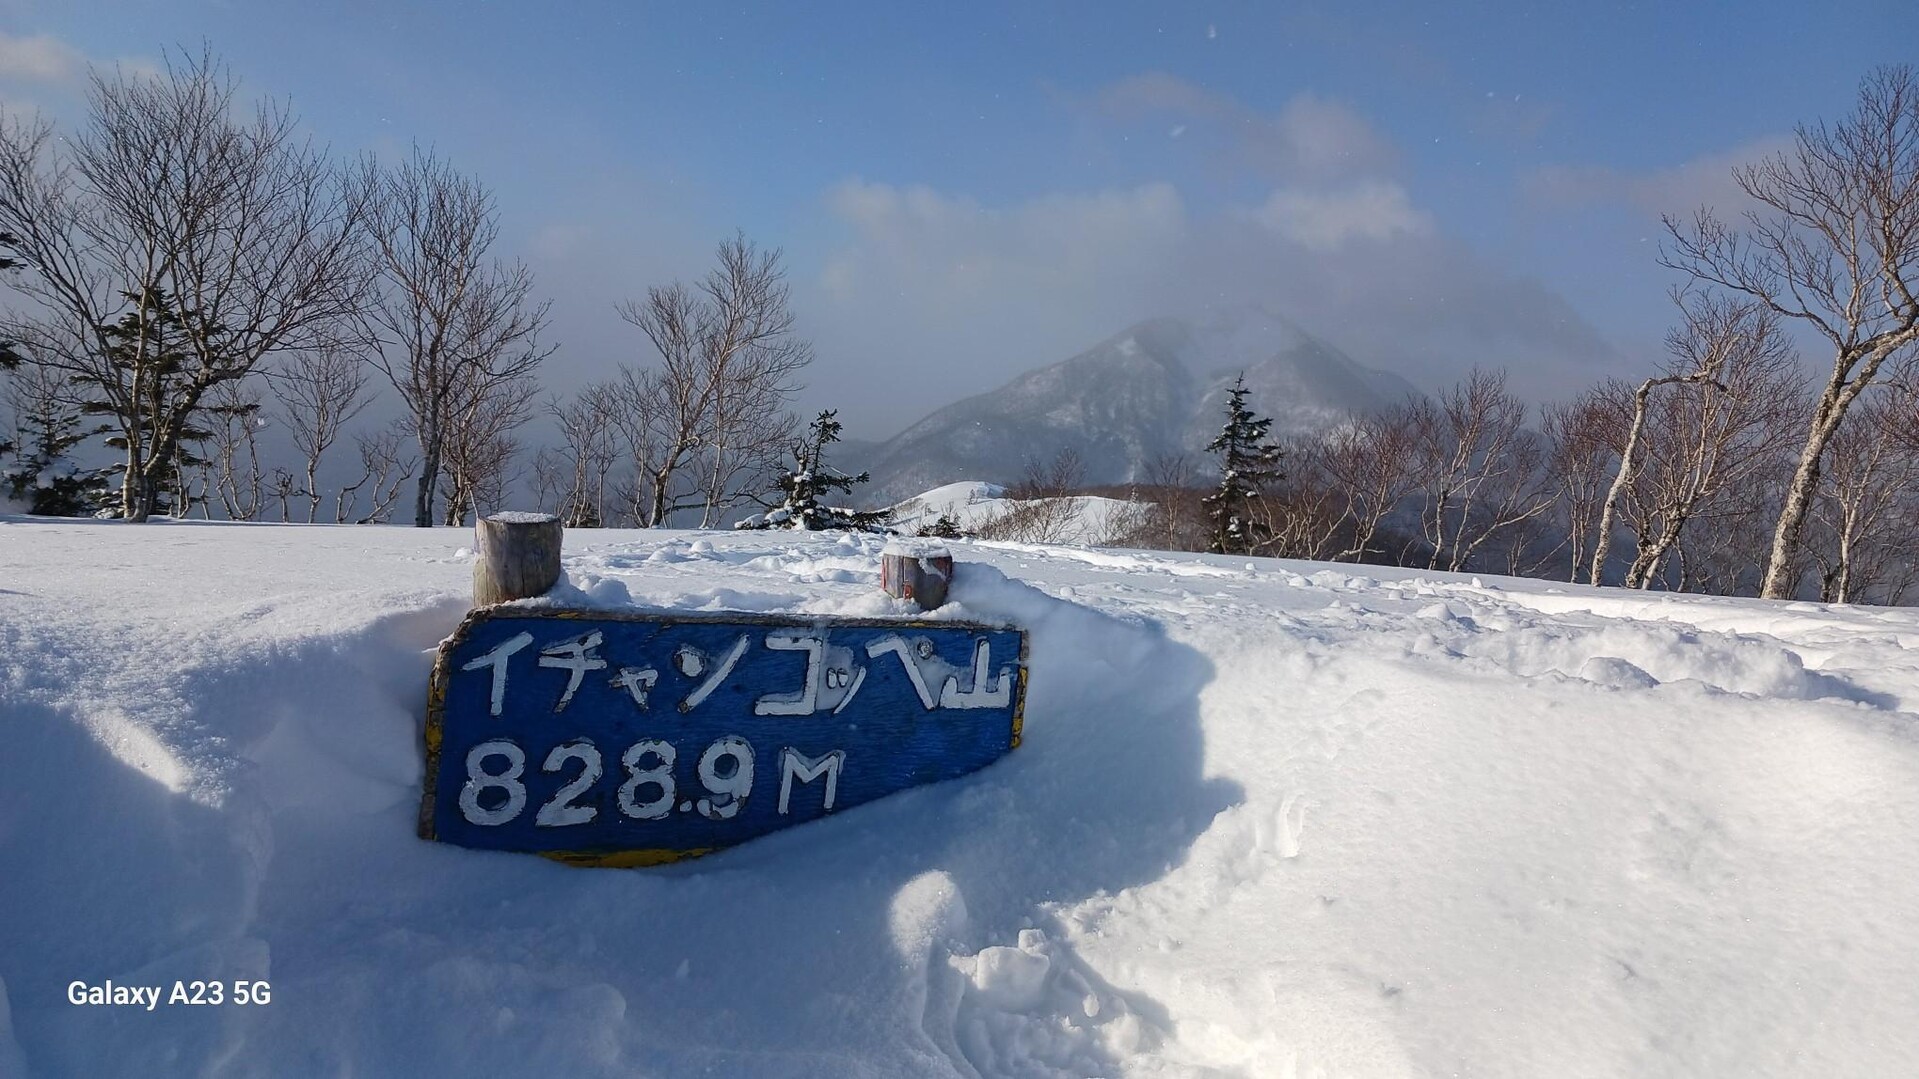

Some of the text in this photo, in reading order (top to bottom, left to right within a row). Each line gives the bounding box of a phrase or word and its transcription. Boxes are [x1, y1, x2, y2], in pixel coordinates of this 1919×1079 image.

[460, 629, 1011, 716] イチャンコッペ山
